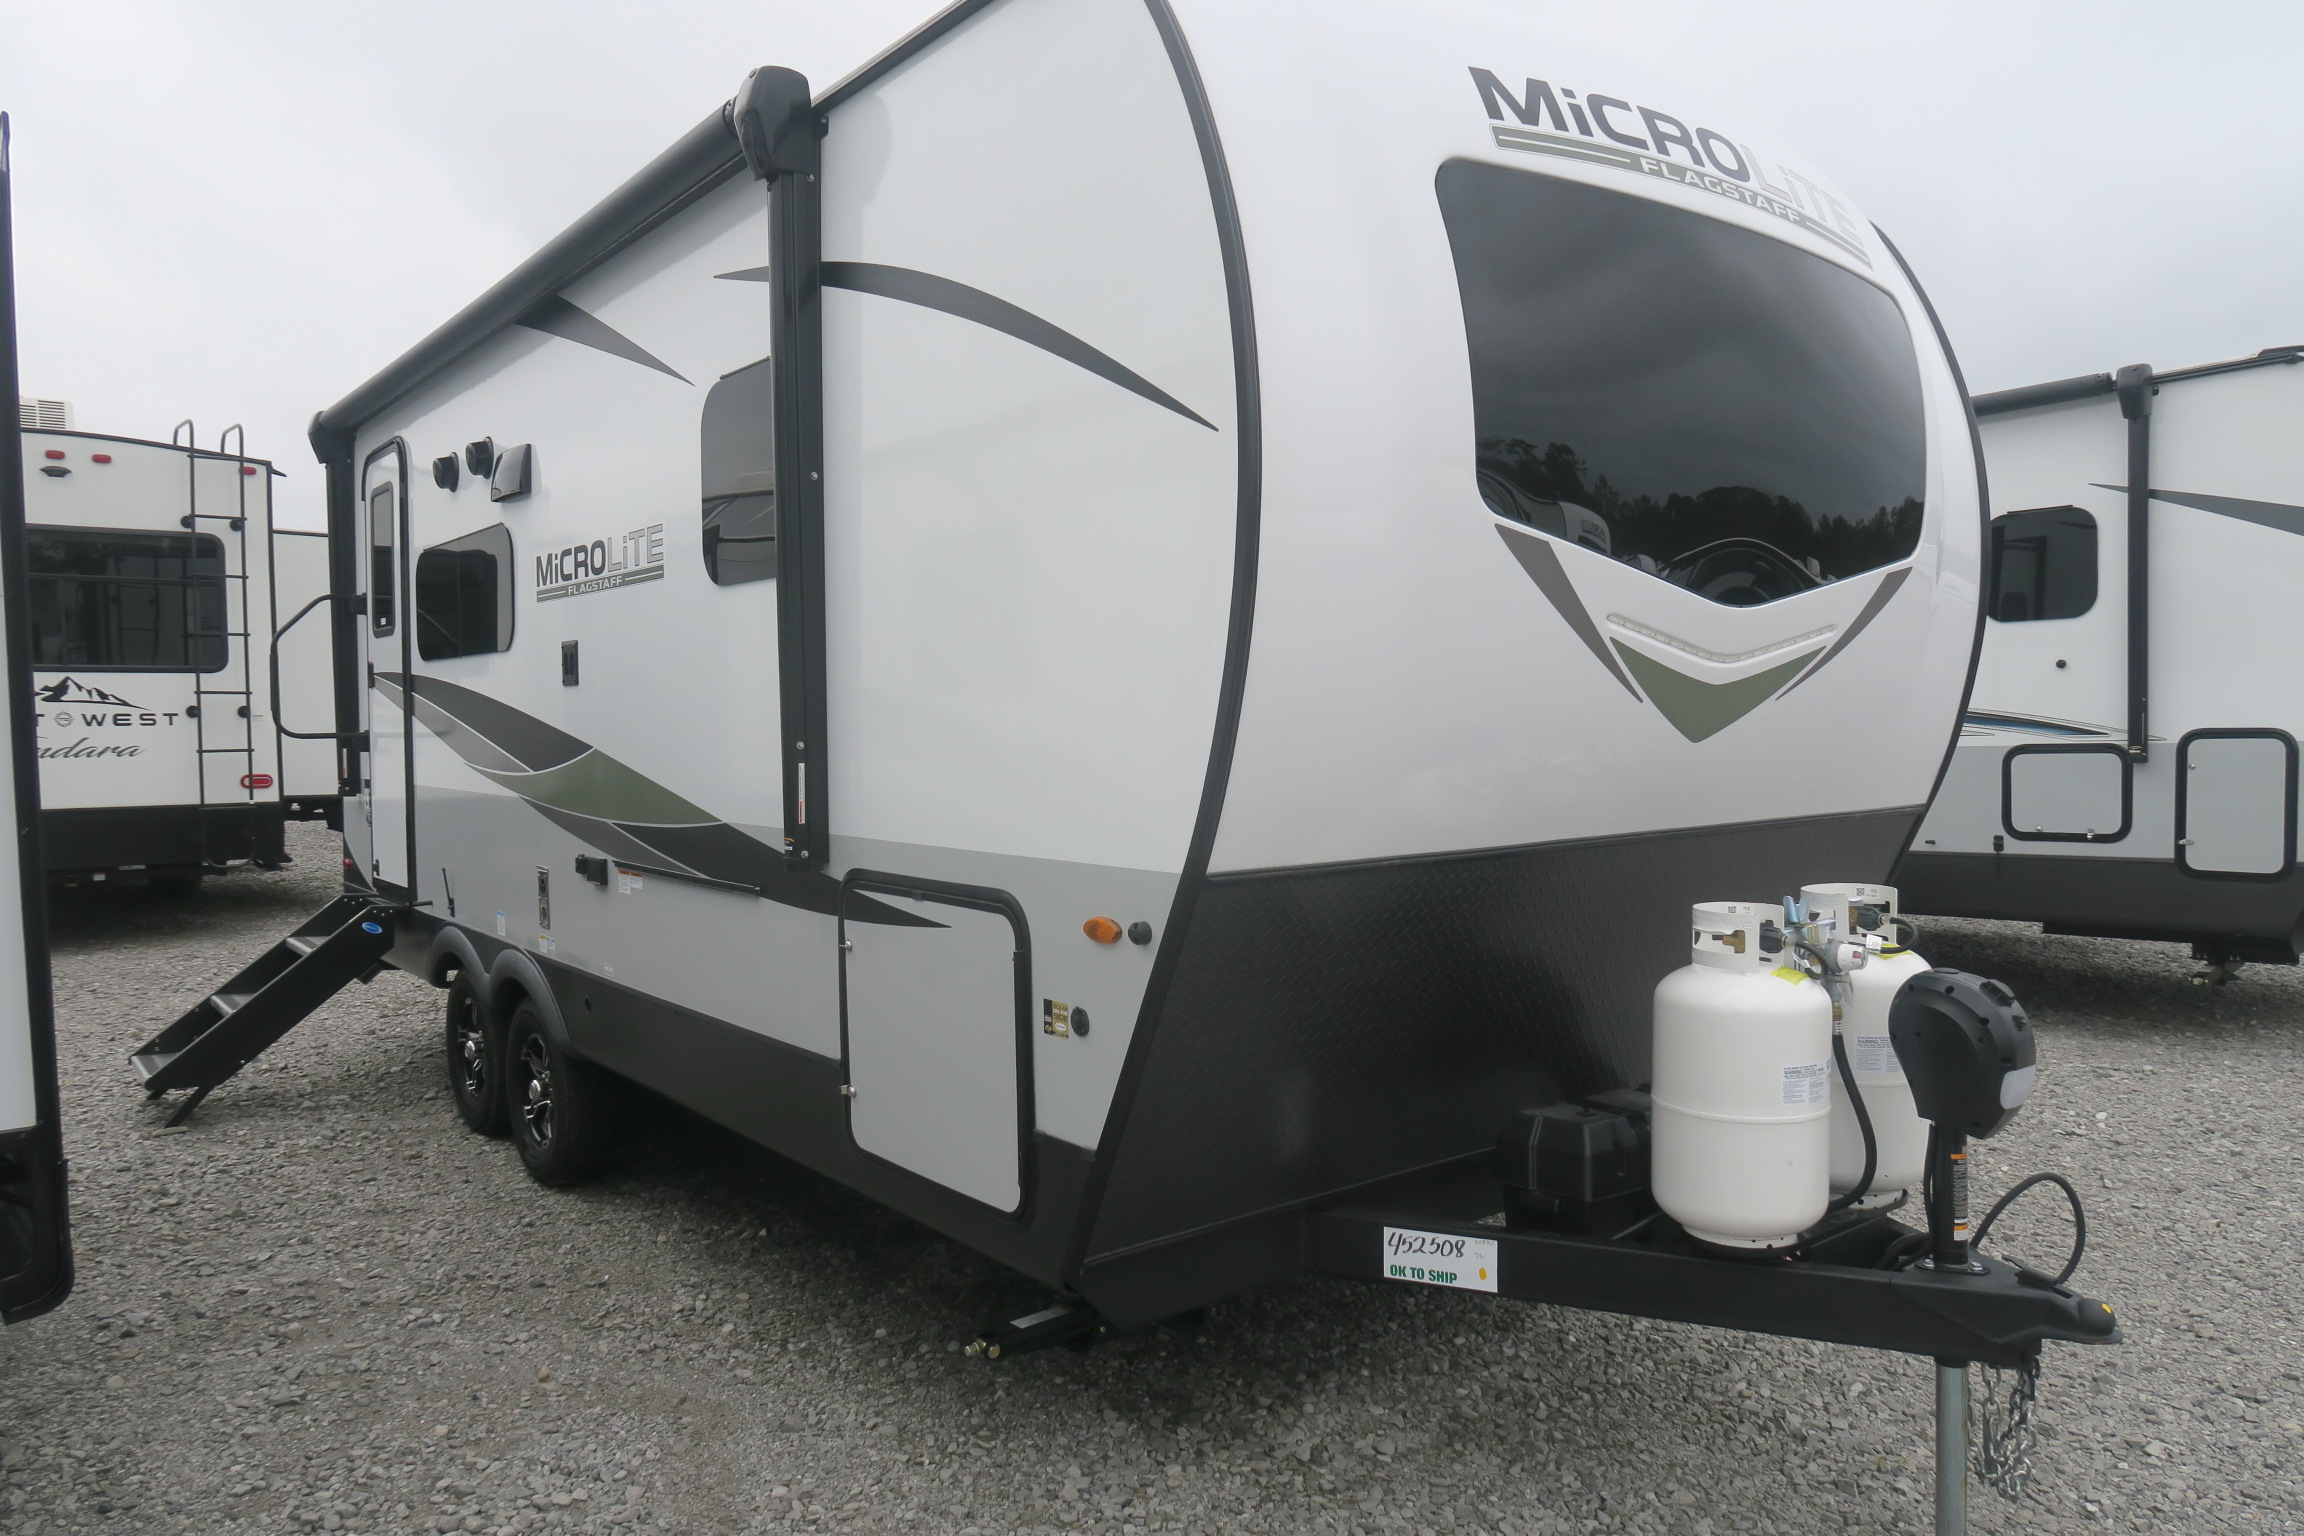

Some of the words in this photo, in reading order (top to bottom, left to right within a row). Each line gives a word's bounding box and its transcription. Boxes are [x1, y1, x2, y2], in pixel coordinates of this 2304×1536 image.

[1639, 156, 1801, 224] FLAGSTAFF
[567, 575, 623, 596] FLAGSTAFF
[81, 712, 179, 727] WEST
[1387, 1231, 1466, 1258] 452508
[1390, 1264, 1407, 1278] OK
[1410, 1266, 1425, 1280] TO
[1428, 1269, 1458, 1284] SHIP
